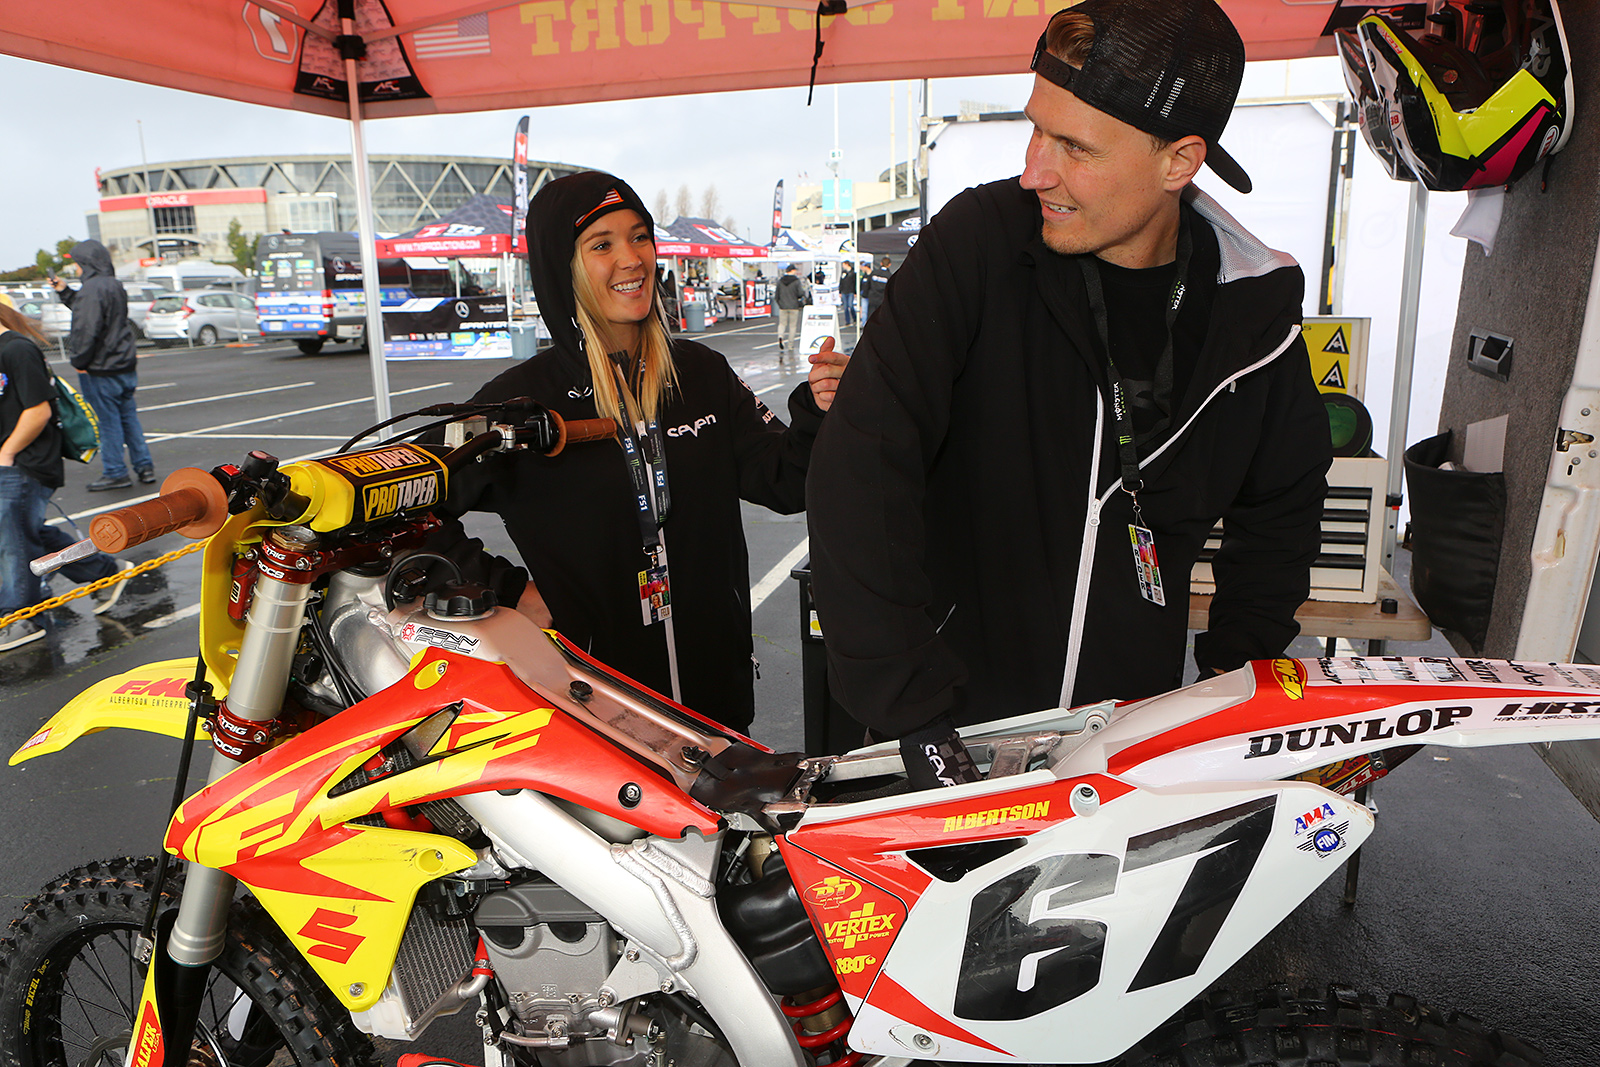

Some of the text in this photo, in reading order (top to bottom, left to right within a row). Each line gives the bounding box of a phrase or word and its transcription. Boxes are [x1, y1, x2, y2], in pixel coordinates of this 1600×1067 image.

[624, 437, 635, 454] FS1
[338, 448, 424, 474] PROTAPER
[656, 470, 665, 488] FS1
[367, 475, 436, 518] PROTAPER
[638, 494, 648, 511] FS1
[112, 677, 189, 699] FM
[109, 696, 148, 706] ALBERTSON
[1244, 706, 1473, 760] DUNLOP
[943, 800, 1051, 833] ALBERTSON
[1293, 803, 1337, 835] AMA
[1316, 833, 1338, 851] FIM
[823, 913, 897, 938] VERTEX
[25, 977, 41, 1007] EXCEL
[134, 1022, 158, 1067] ALFER
